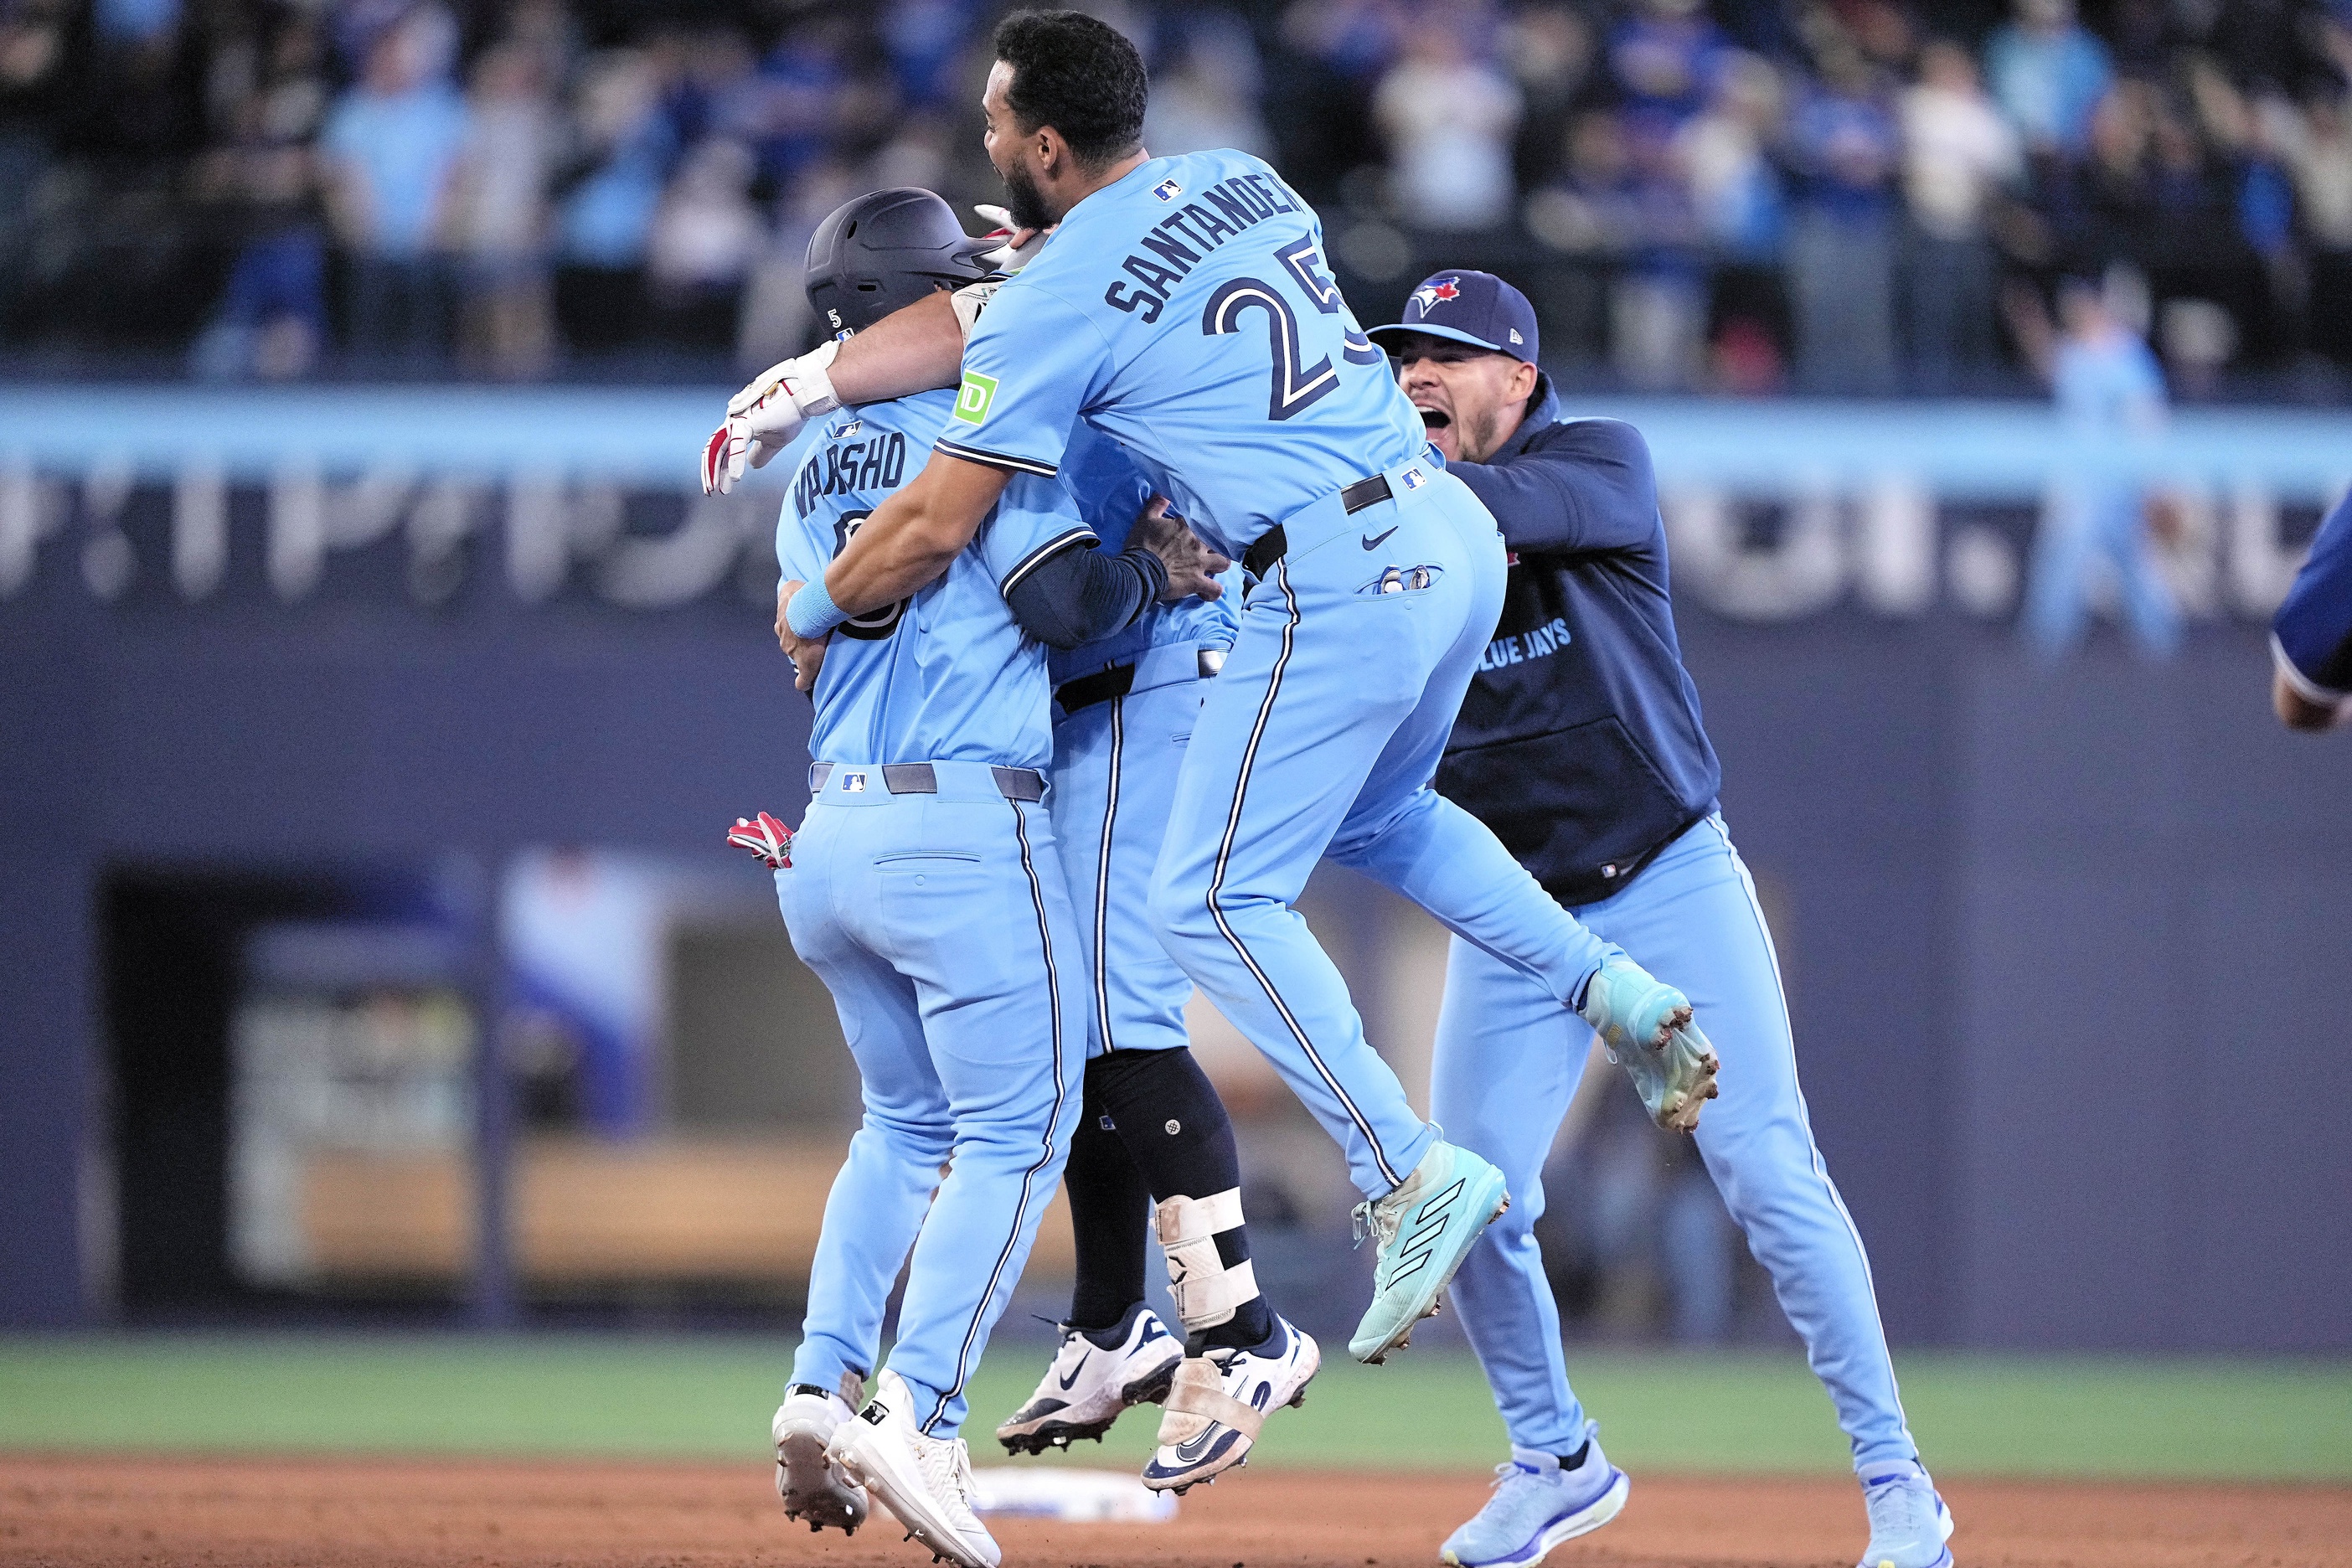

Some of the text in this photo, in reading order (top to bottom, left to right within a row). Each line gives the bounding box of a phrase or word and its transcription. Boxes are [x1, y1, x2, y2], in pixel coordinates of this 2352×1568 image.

[1104, 171, 1307, 325] SANTANDER
[827, 308, 842, 328] 5
[1202, 229, 1381, 421] 25
[794, 431, 906, 520] VARSHO
[1477, 617, 1571, 672] LUE JAYS
